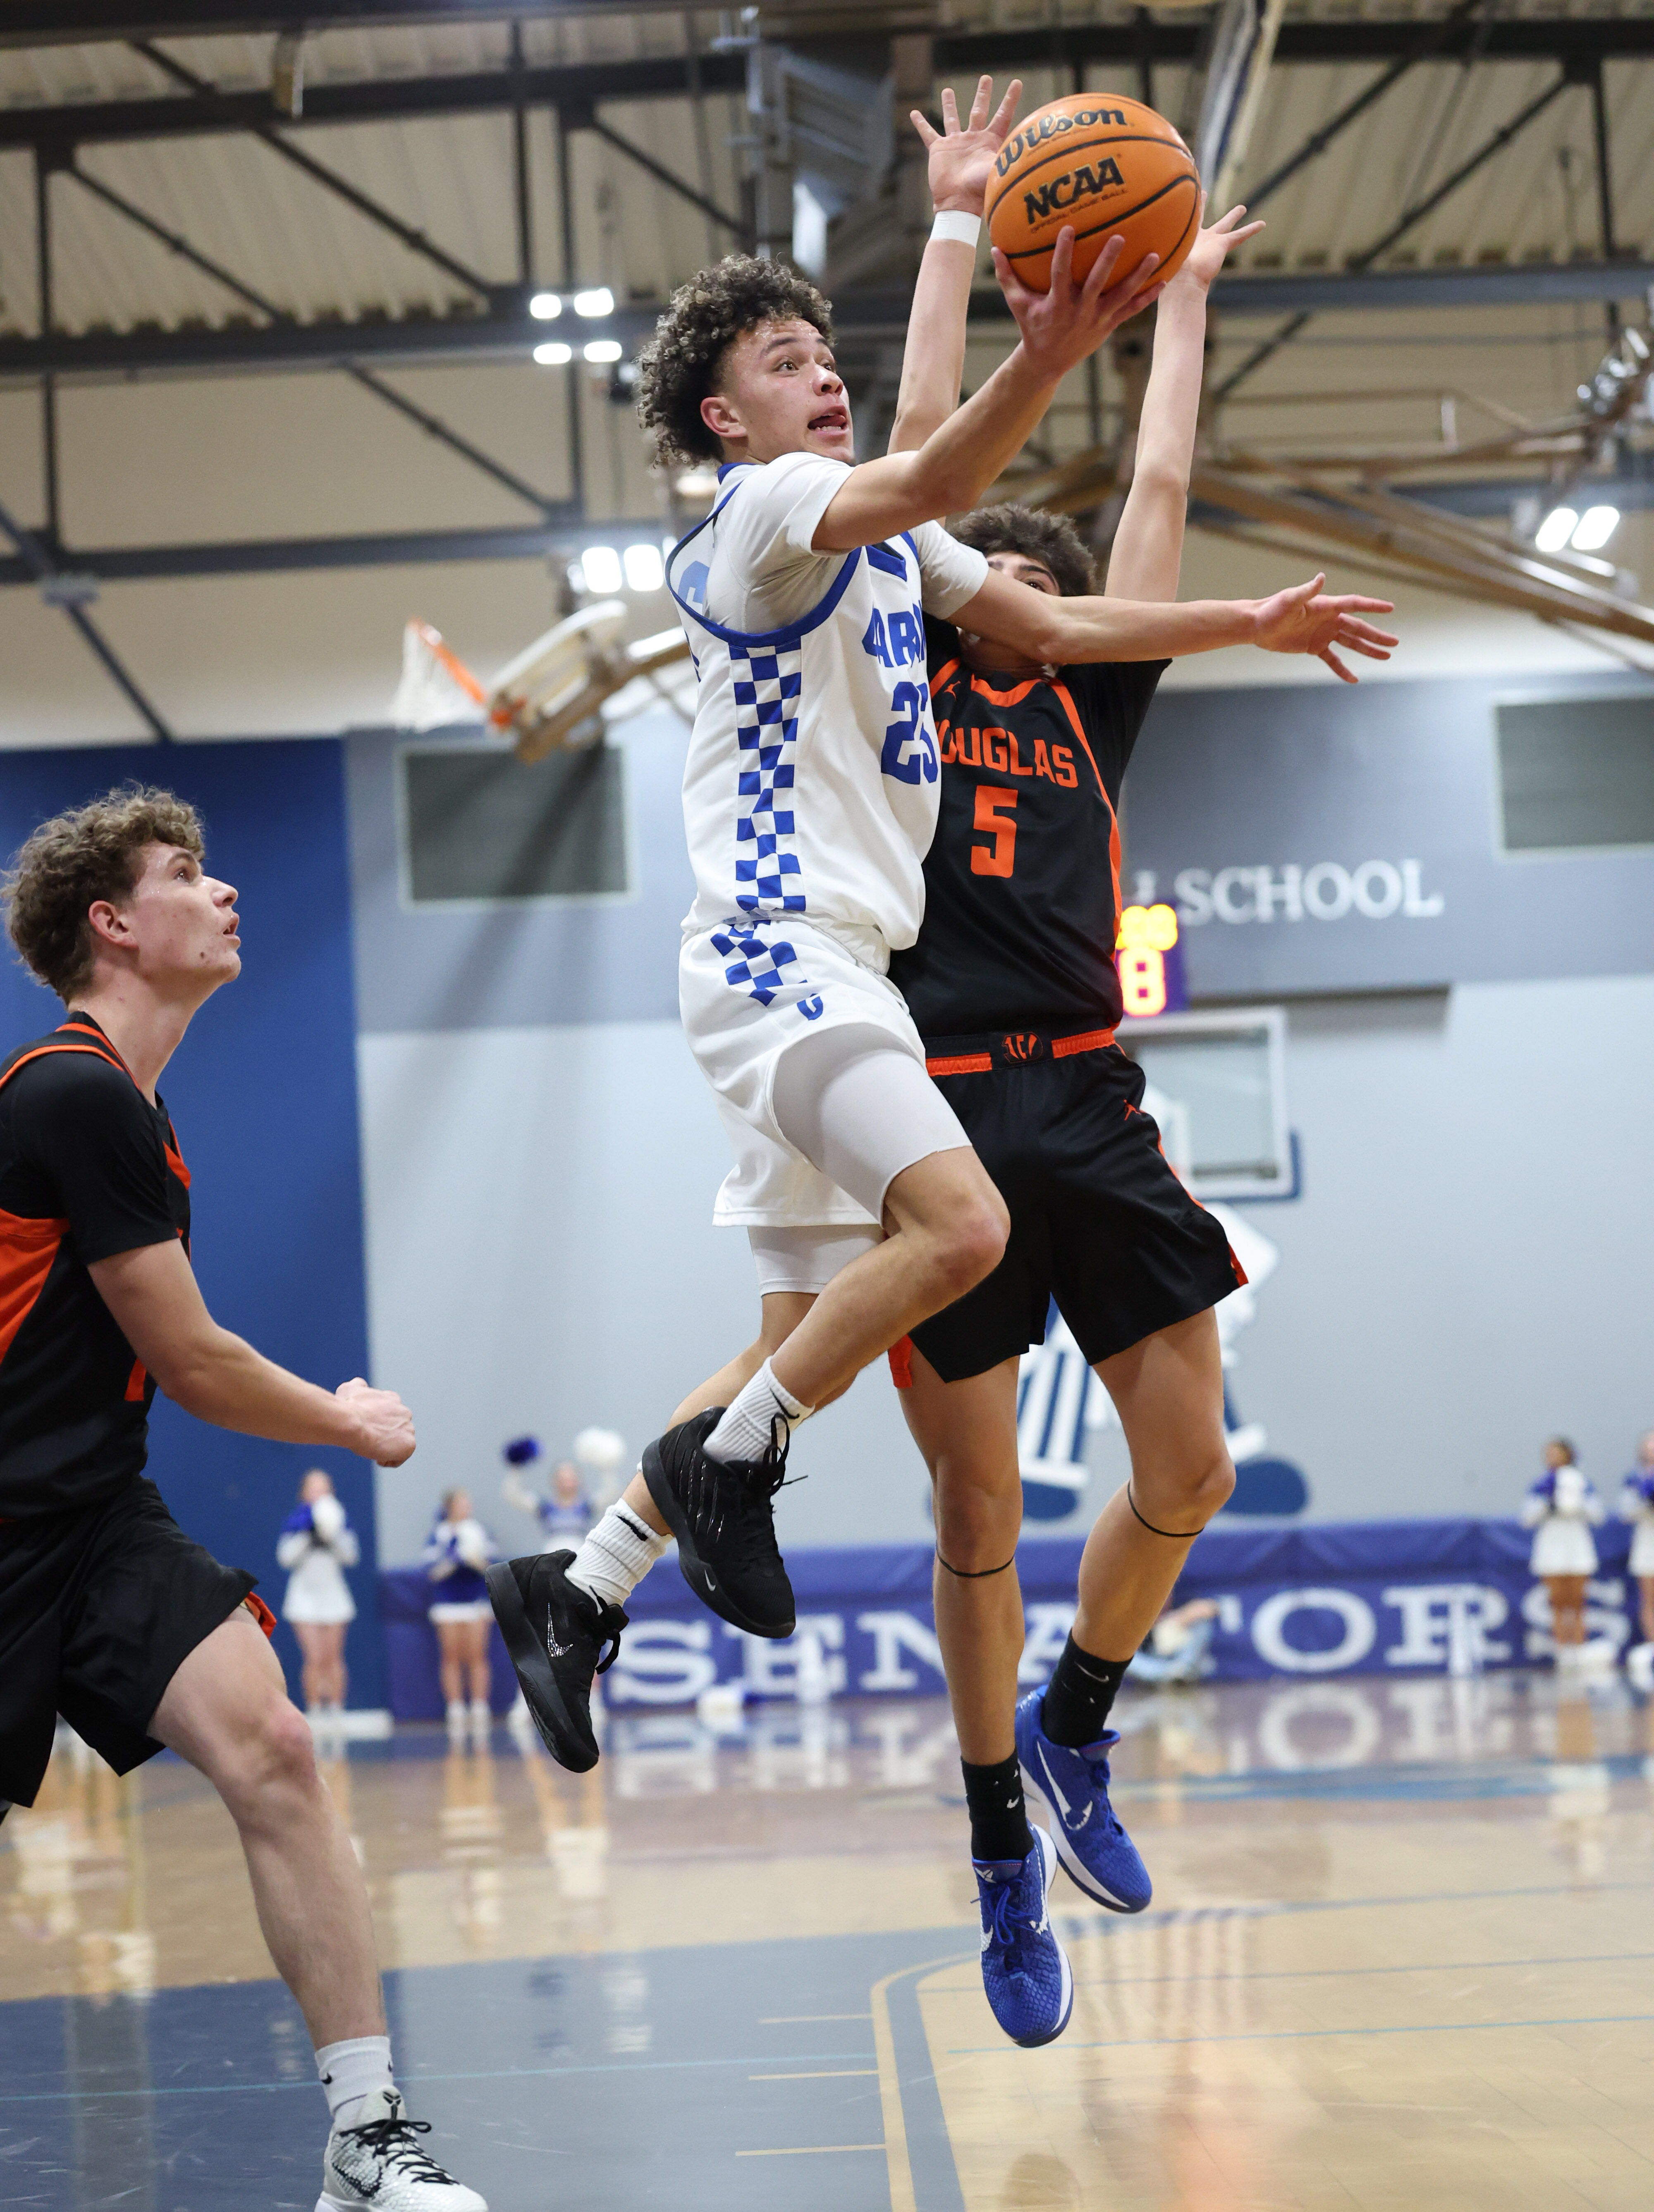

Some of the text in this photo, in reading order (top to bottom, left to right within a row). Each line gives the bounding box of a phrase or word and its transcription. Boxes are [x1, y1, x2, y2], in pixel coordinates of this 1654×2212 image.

[995, 109, 1128, 177] Wilson
[1023, 155, 1125, 224] NCAA
[935, 718, 1078, 788] OUGLAS
[970, 785, 1018, 878] 5
[1173, 859, 1445, 927] SCHOOL
